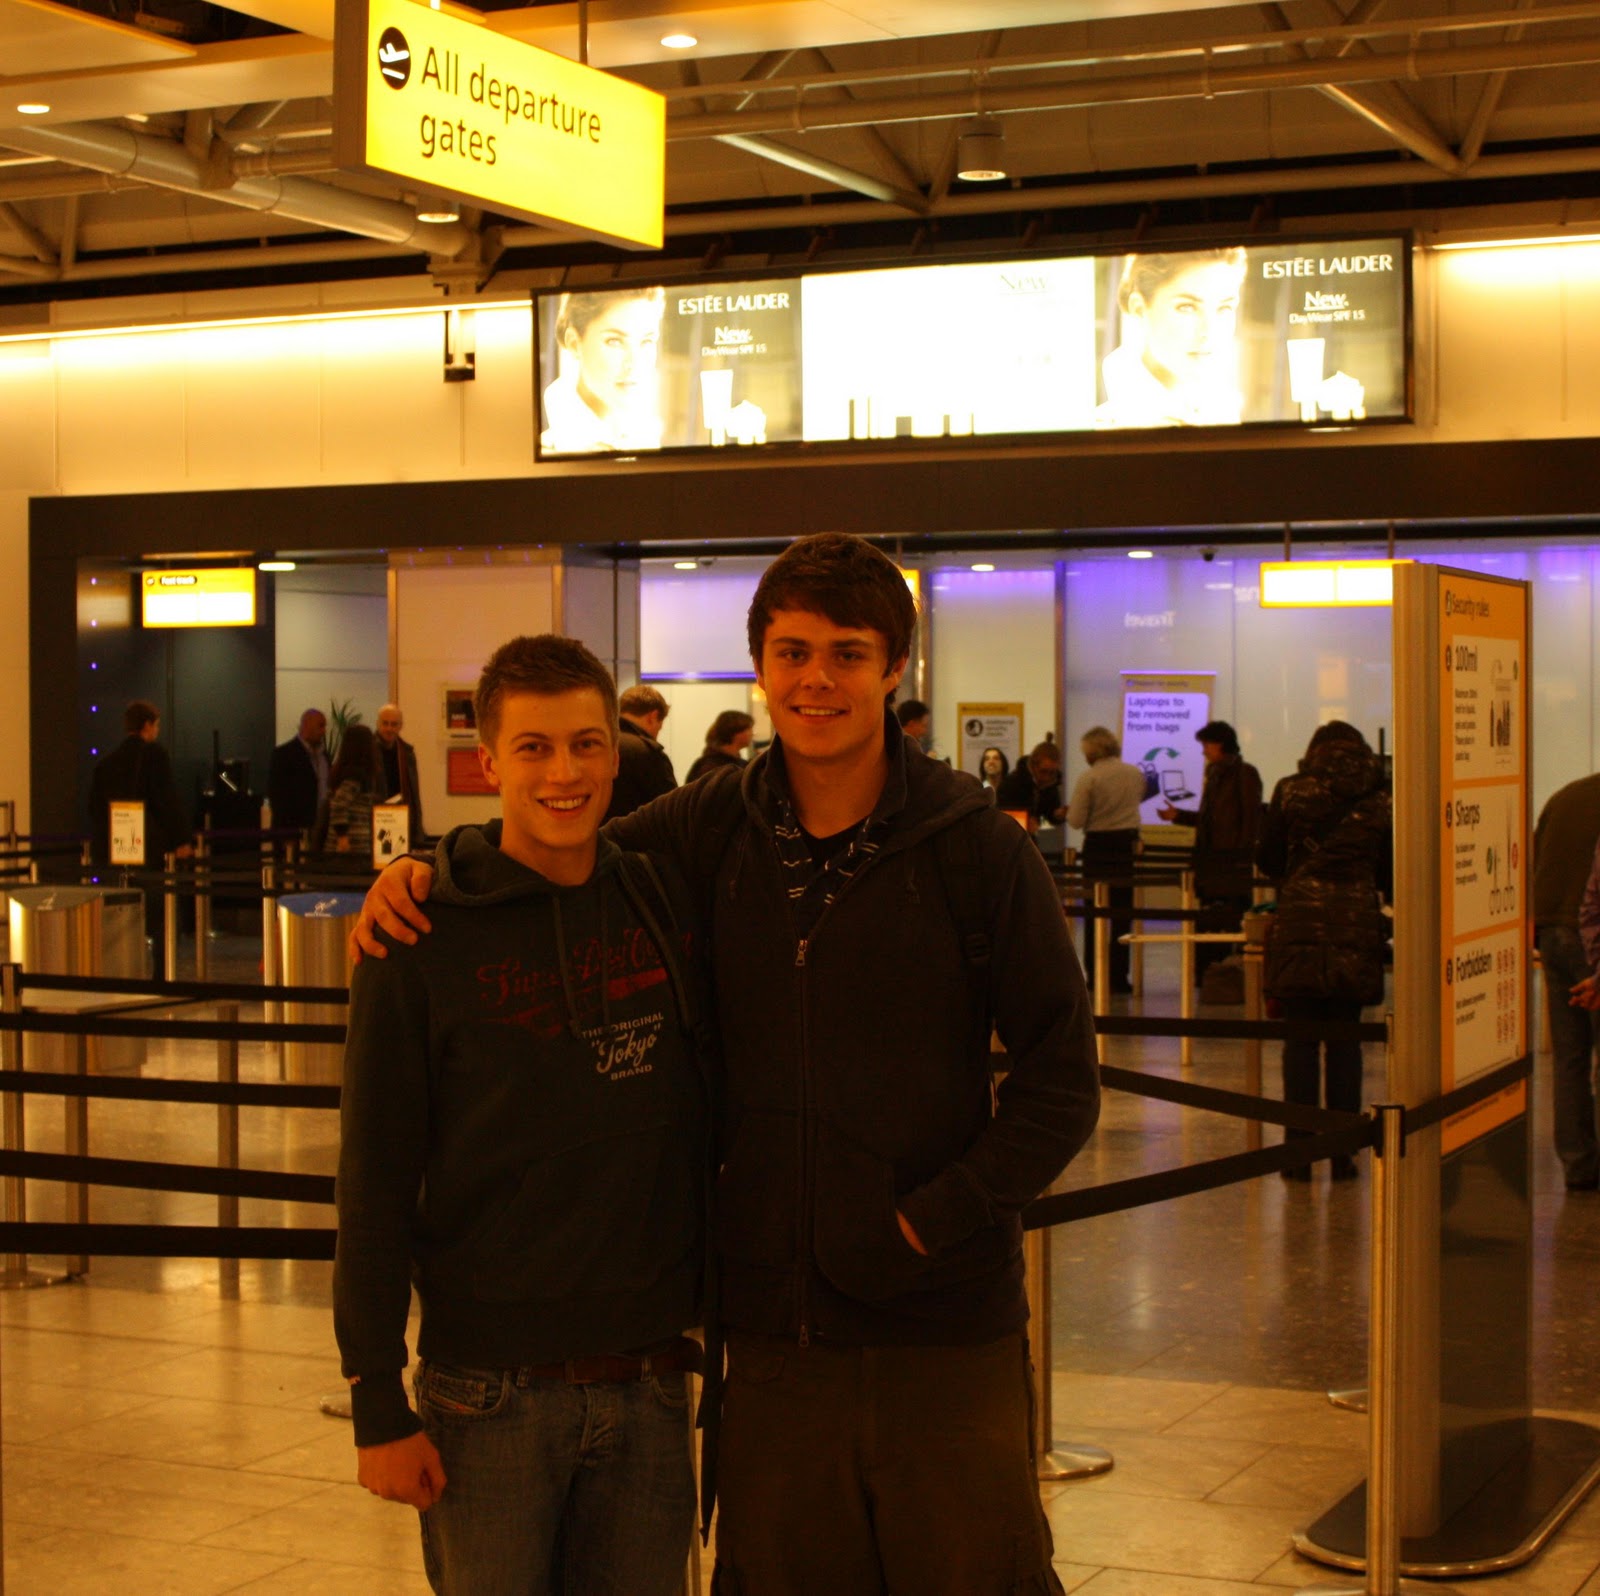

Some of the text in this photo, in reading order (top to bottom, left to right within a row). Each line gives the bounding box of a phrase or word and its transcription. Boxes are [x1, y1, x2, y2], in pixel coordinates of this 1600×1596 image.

[421, 46, 601, 143] All departure
[420, 113, 497, 165] gates
[1262, 254, 1393, 279] ESTÉE LAUDER
[726, 292, 790, 312] LAUDER
[1353, 309, 1366, 321] 15
[1455, 645, 1477, 672] 100ml
[1128, 696, 1185, 708] Laptops to
[1127, 709, 1190, 719] be removed
[1127, 721, 1180, 734] from bags
[1455, 800, 1481, 831] Sharps
[1455, 951, 1493, 984] Forbidden
[610, 1064, 653, 1081] BRAND
